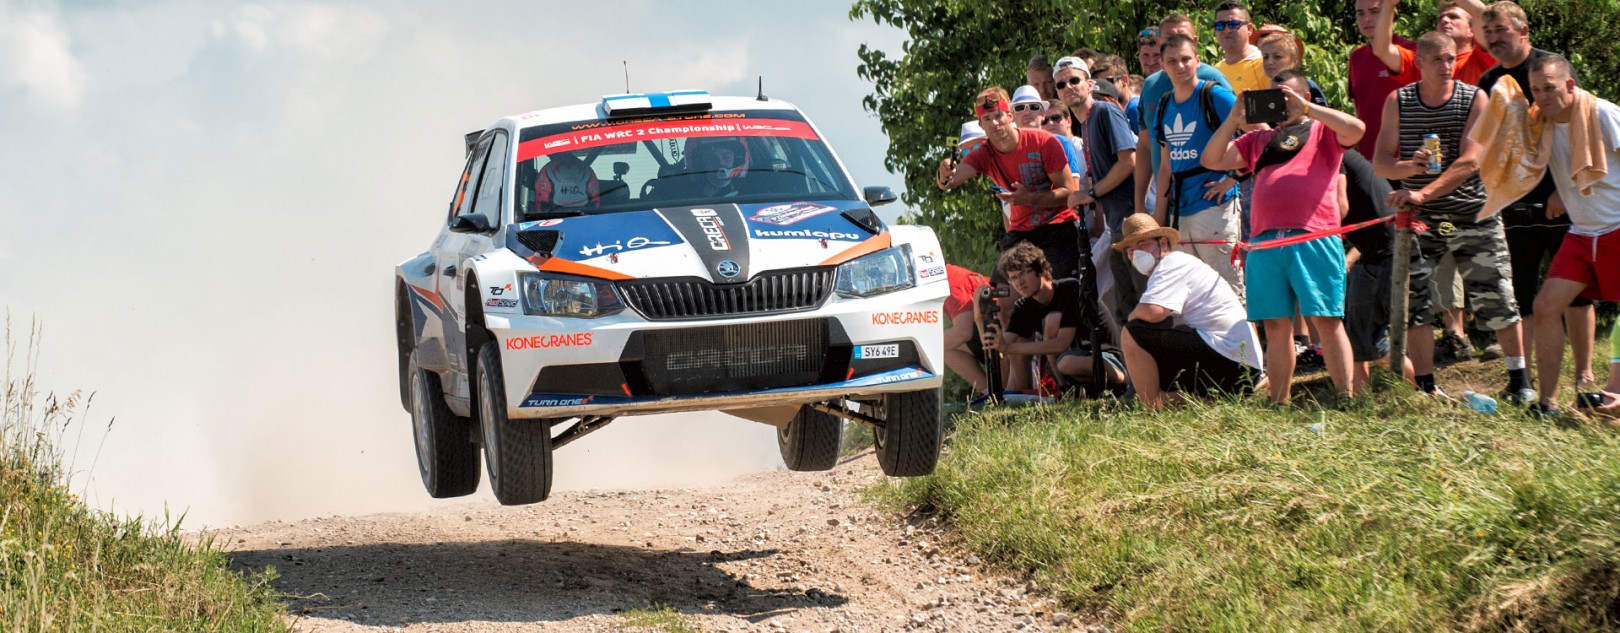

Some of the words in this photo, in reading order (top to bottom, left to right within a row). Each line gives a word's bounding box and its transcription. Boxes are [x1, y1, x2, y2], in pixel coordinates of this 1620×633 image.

[581, 134, 602, 142] FIA
[604, 130, 633, 139] WRC
[648, 124, 735, 135] Championship
[872, 310, 939, 325] KONECRANES
[506, 332, 594, 350] KONECRANES
[865, 347, 881, 357] SY6
[882, 346, 896, 356] 49E
